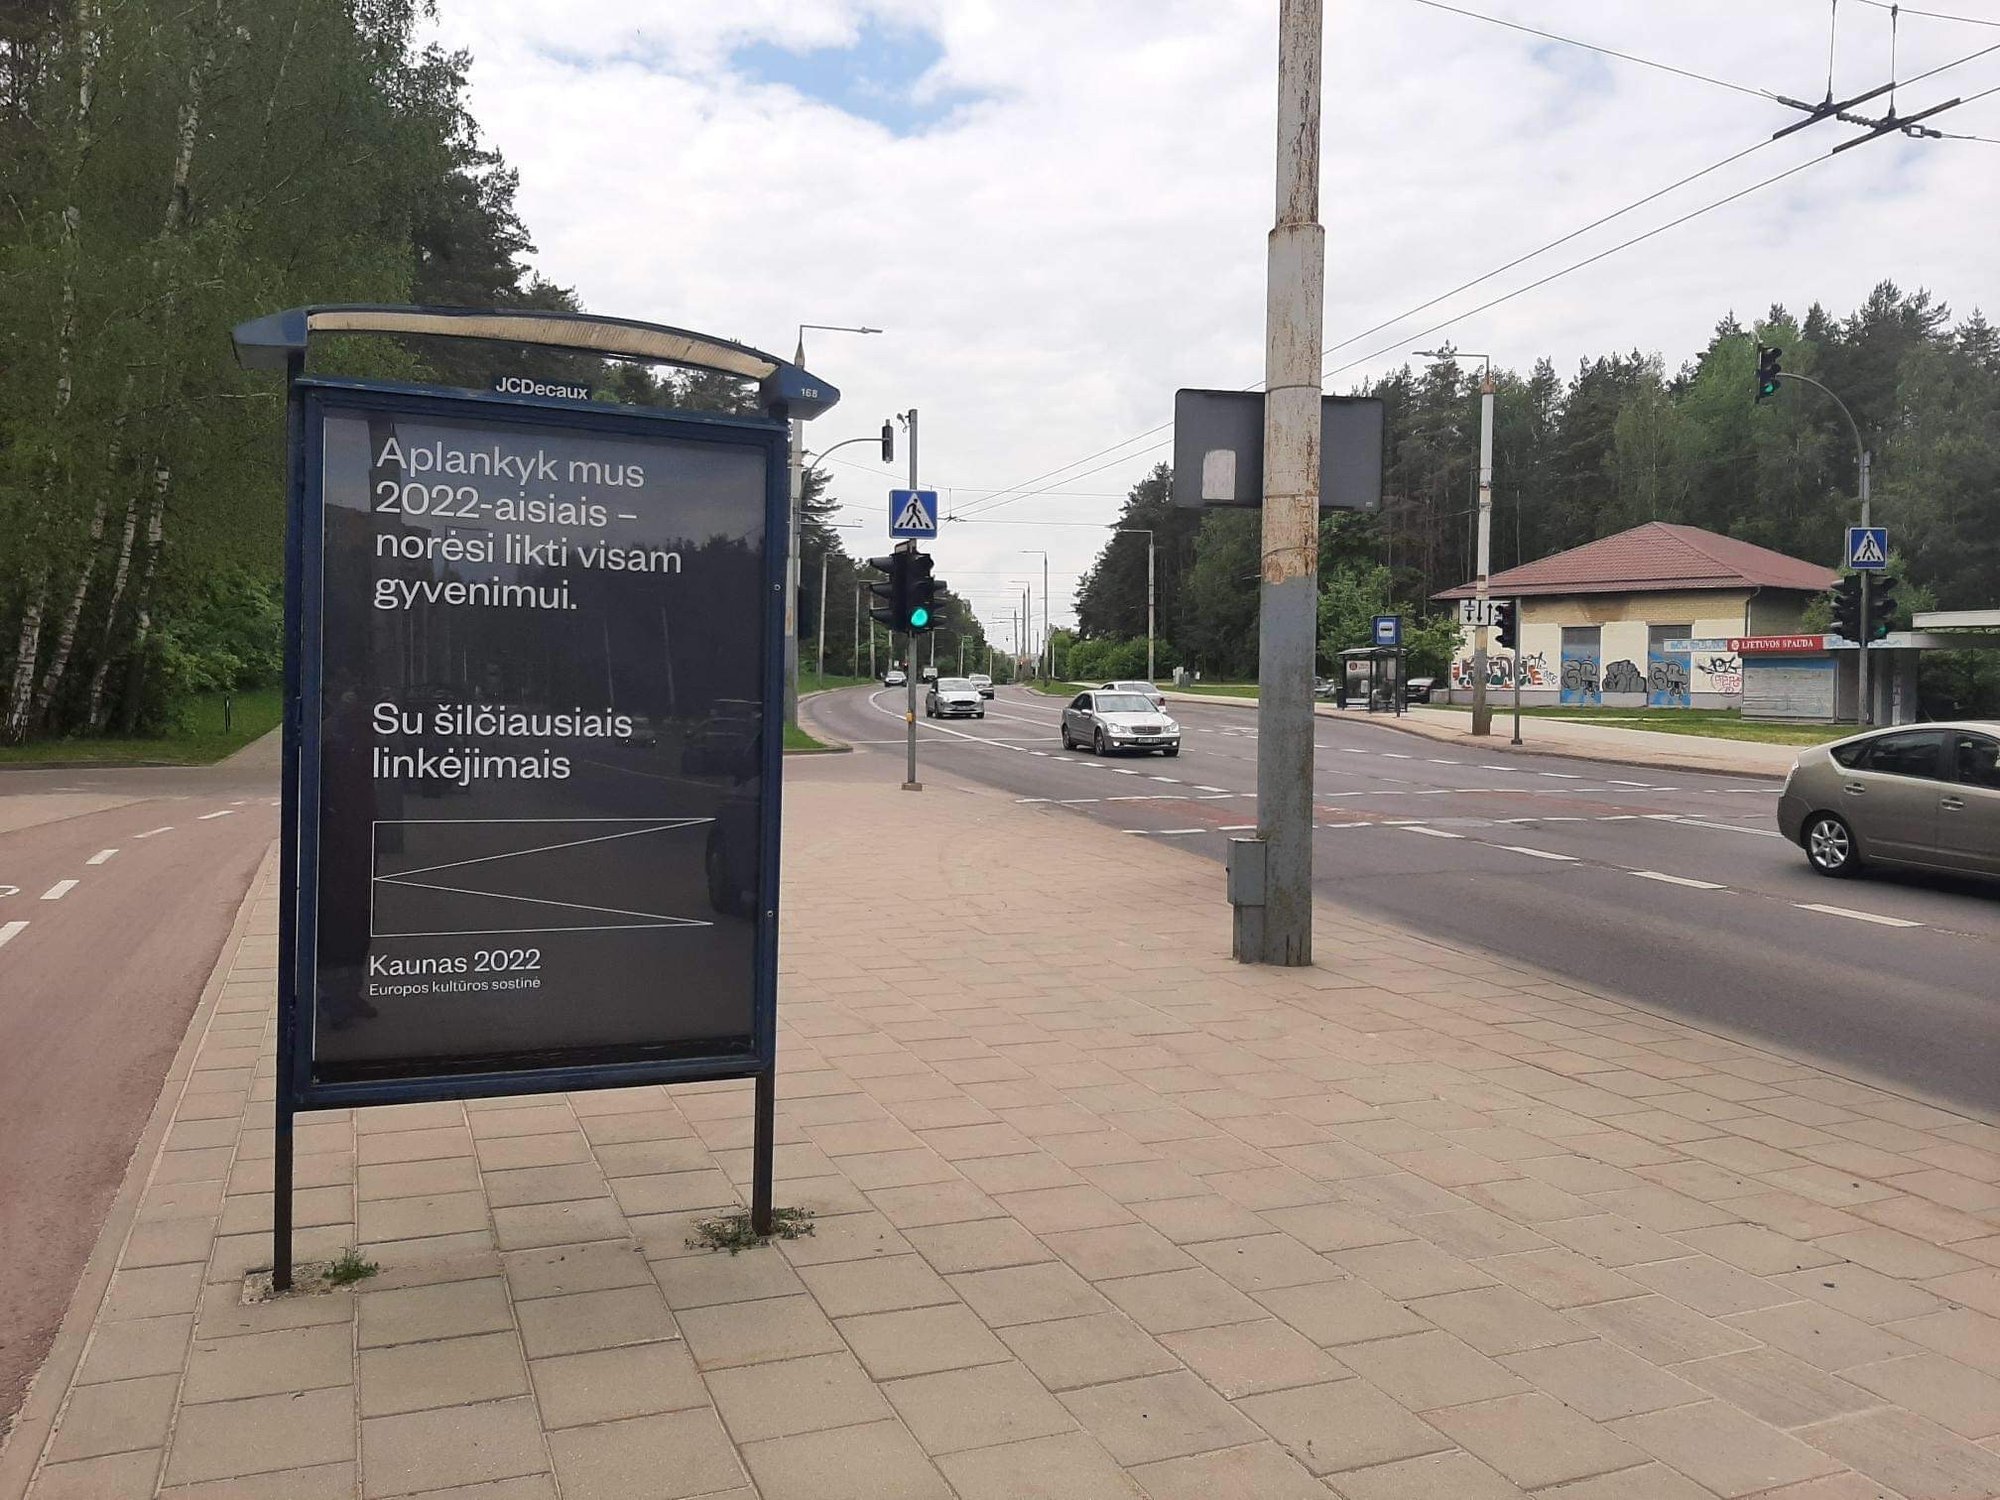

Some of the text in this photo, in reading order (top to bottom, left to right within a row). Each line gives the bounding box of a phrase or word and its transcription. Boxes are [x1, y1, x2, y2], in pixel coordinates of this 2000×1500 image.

[495, 376, 589, 400] JCDecaux
[376, 437, 645, 488] Aplankyk mus
[375, 480, 608, 528] 2022-aisiais
[376, 530, 683, 575] norėsi likti visam
[373, 576, 578, 610] gyvenimui.
[1741, 639, 1814, 649] LIETUVOS SPAUDA
[372, 702, 634, 738] Su šilčiausiais
[372, 747, 571, 787] linkėjimais
[369, 949, 542, 977] Kaunas 2022
[369, 976, 541, 997] Europos kultūros sostinė
